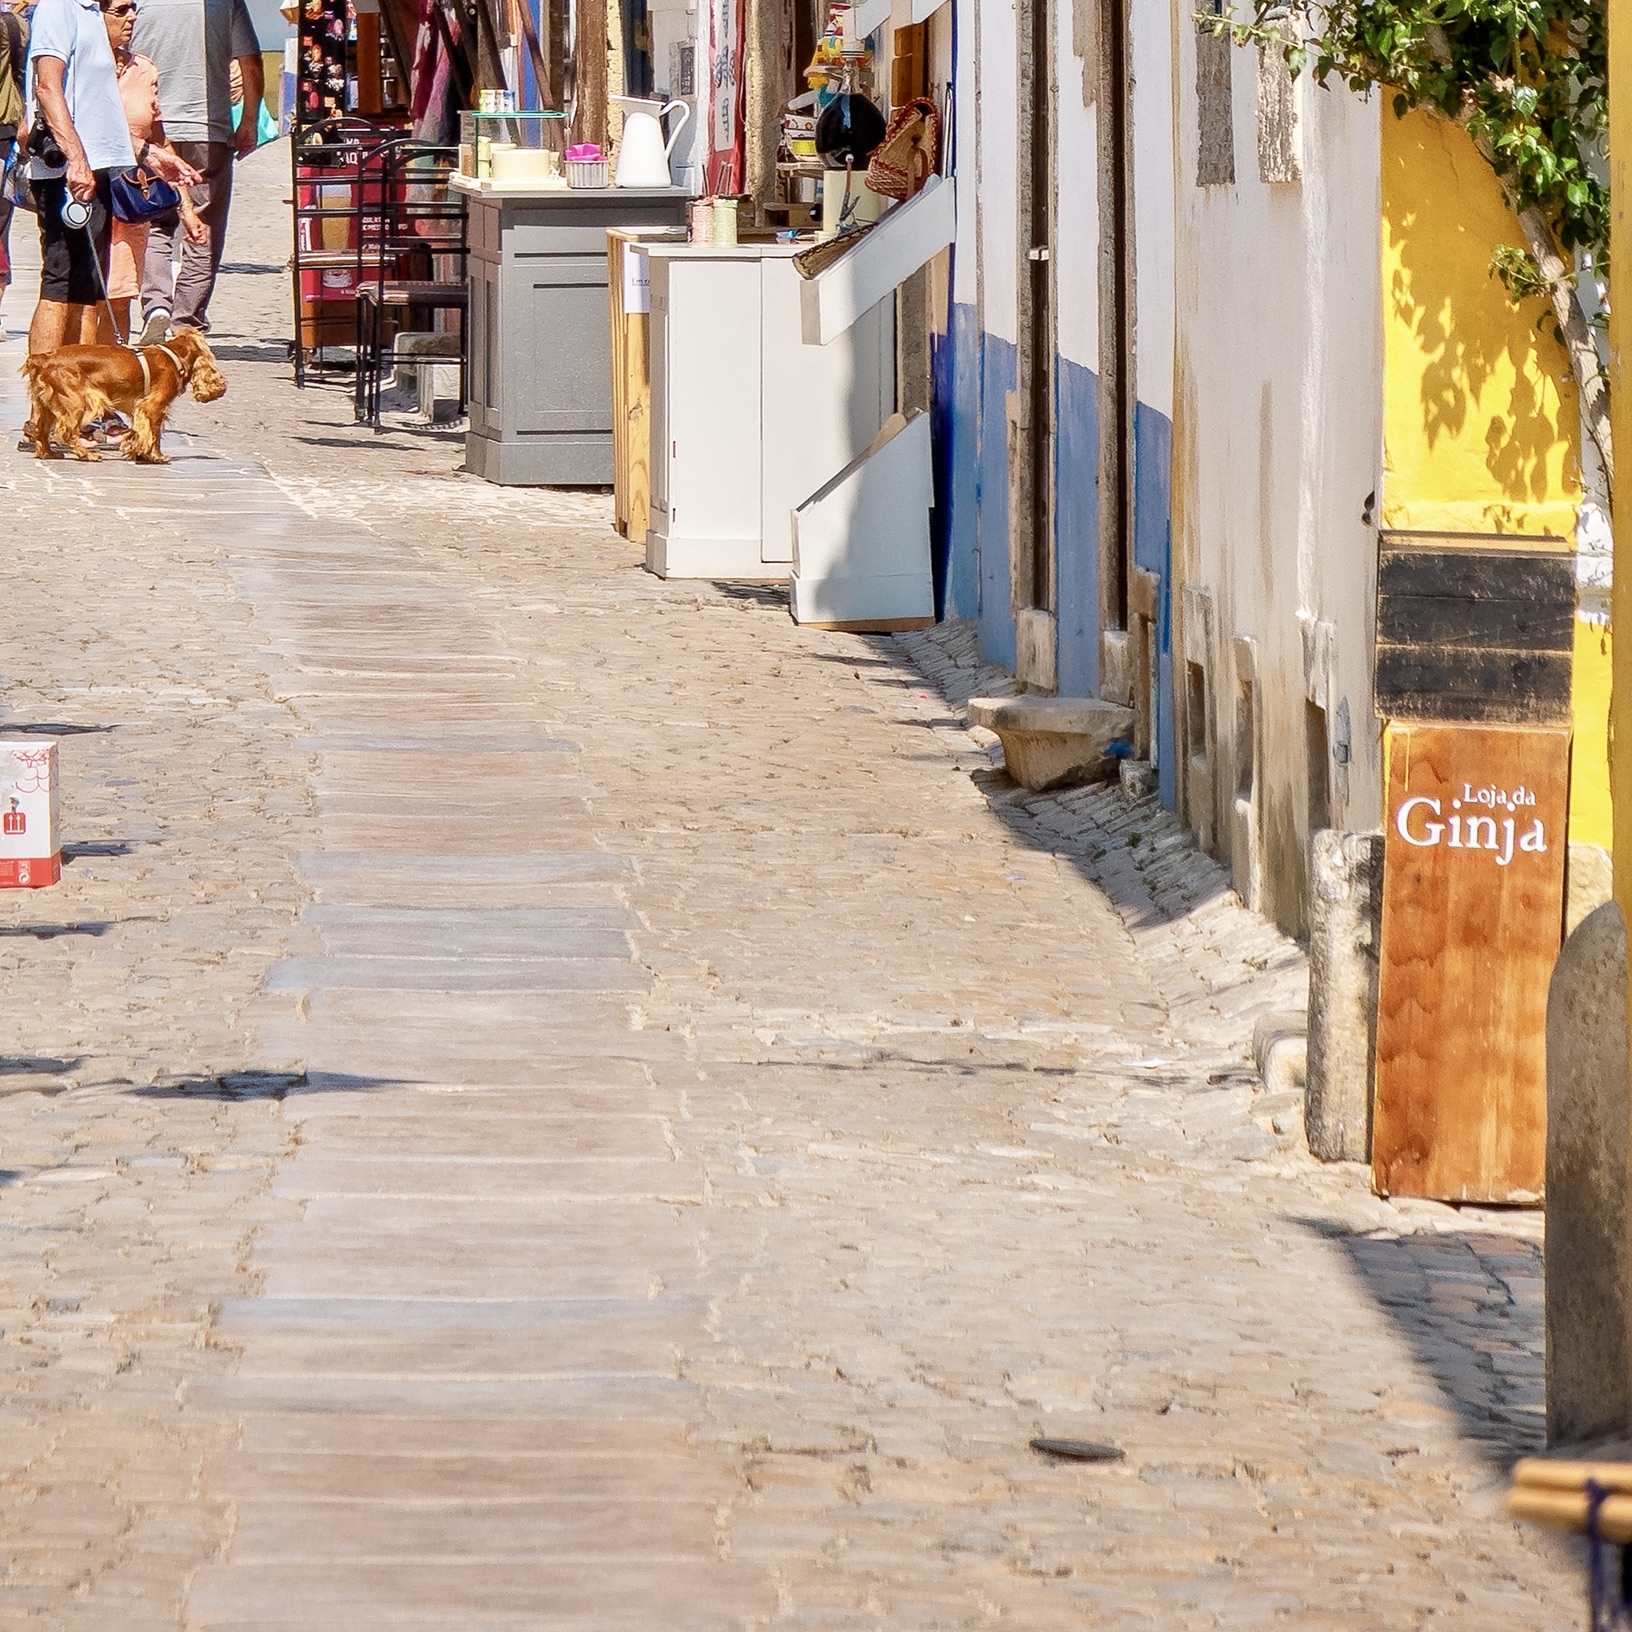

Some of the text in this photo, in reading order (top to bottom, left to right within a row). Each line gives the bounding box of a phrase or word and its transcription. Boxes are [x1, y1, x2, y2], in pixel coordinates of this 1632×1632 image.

[1463, 782, 1536, 809] Loja da
[1395, 796, 1548, 866] Ginja
